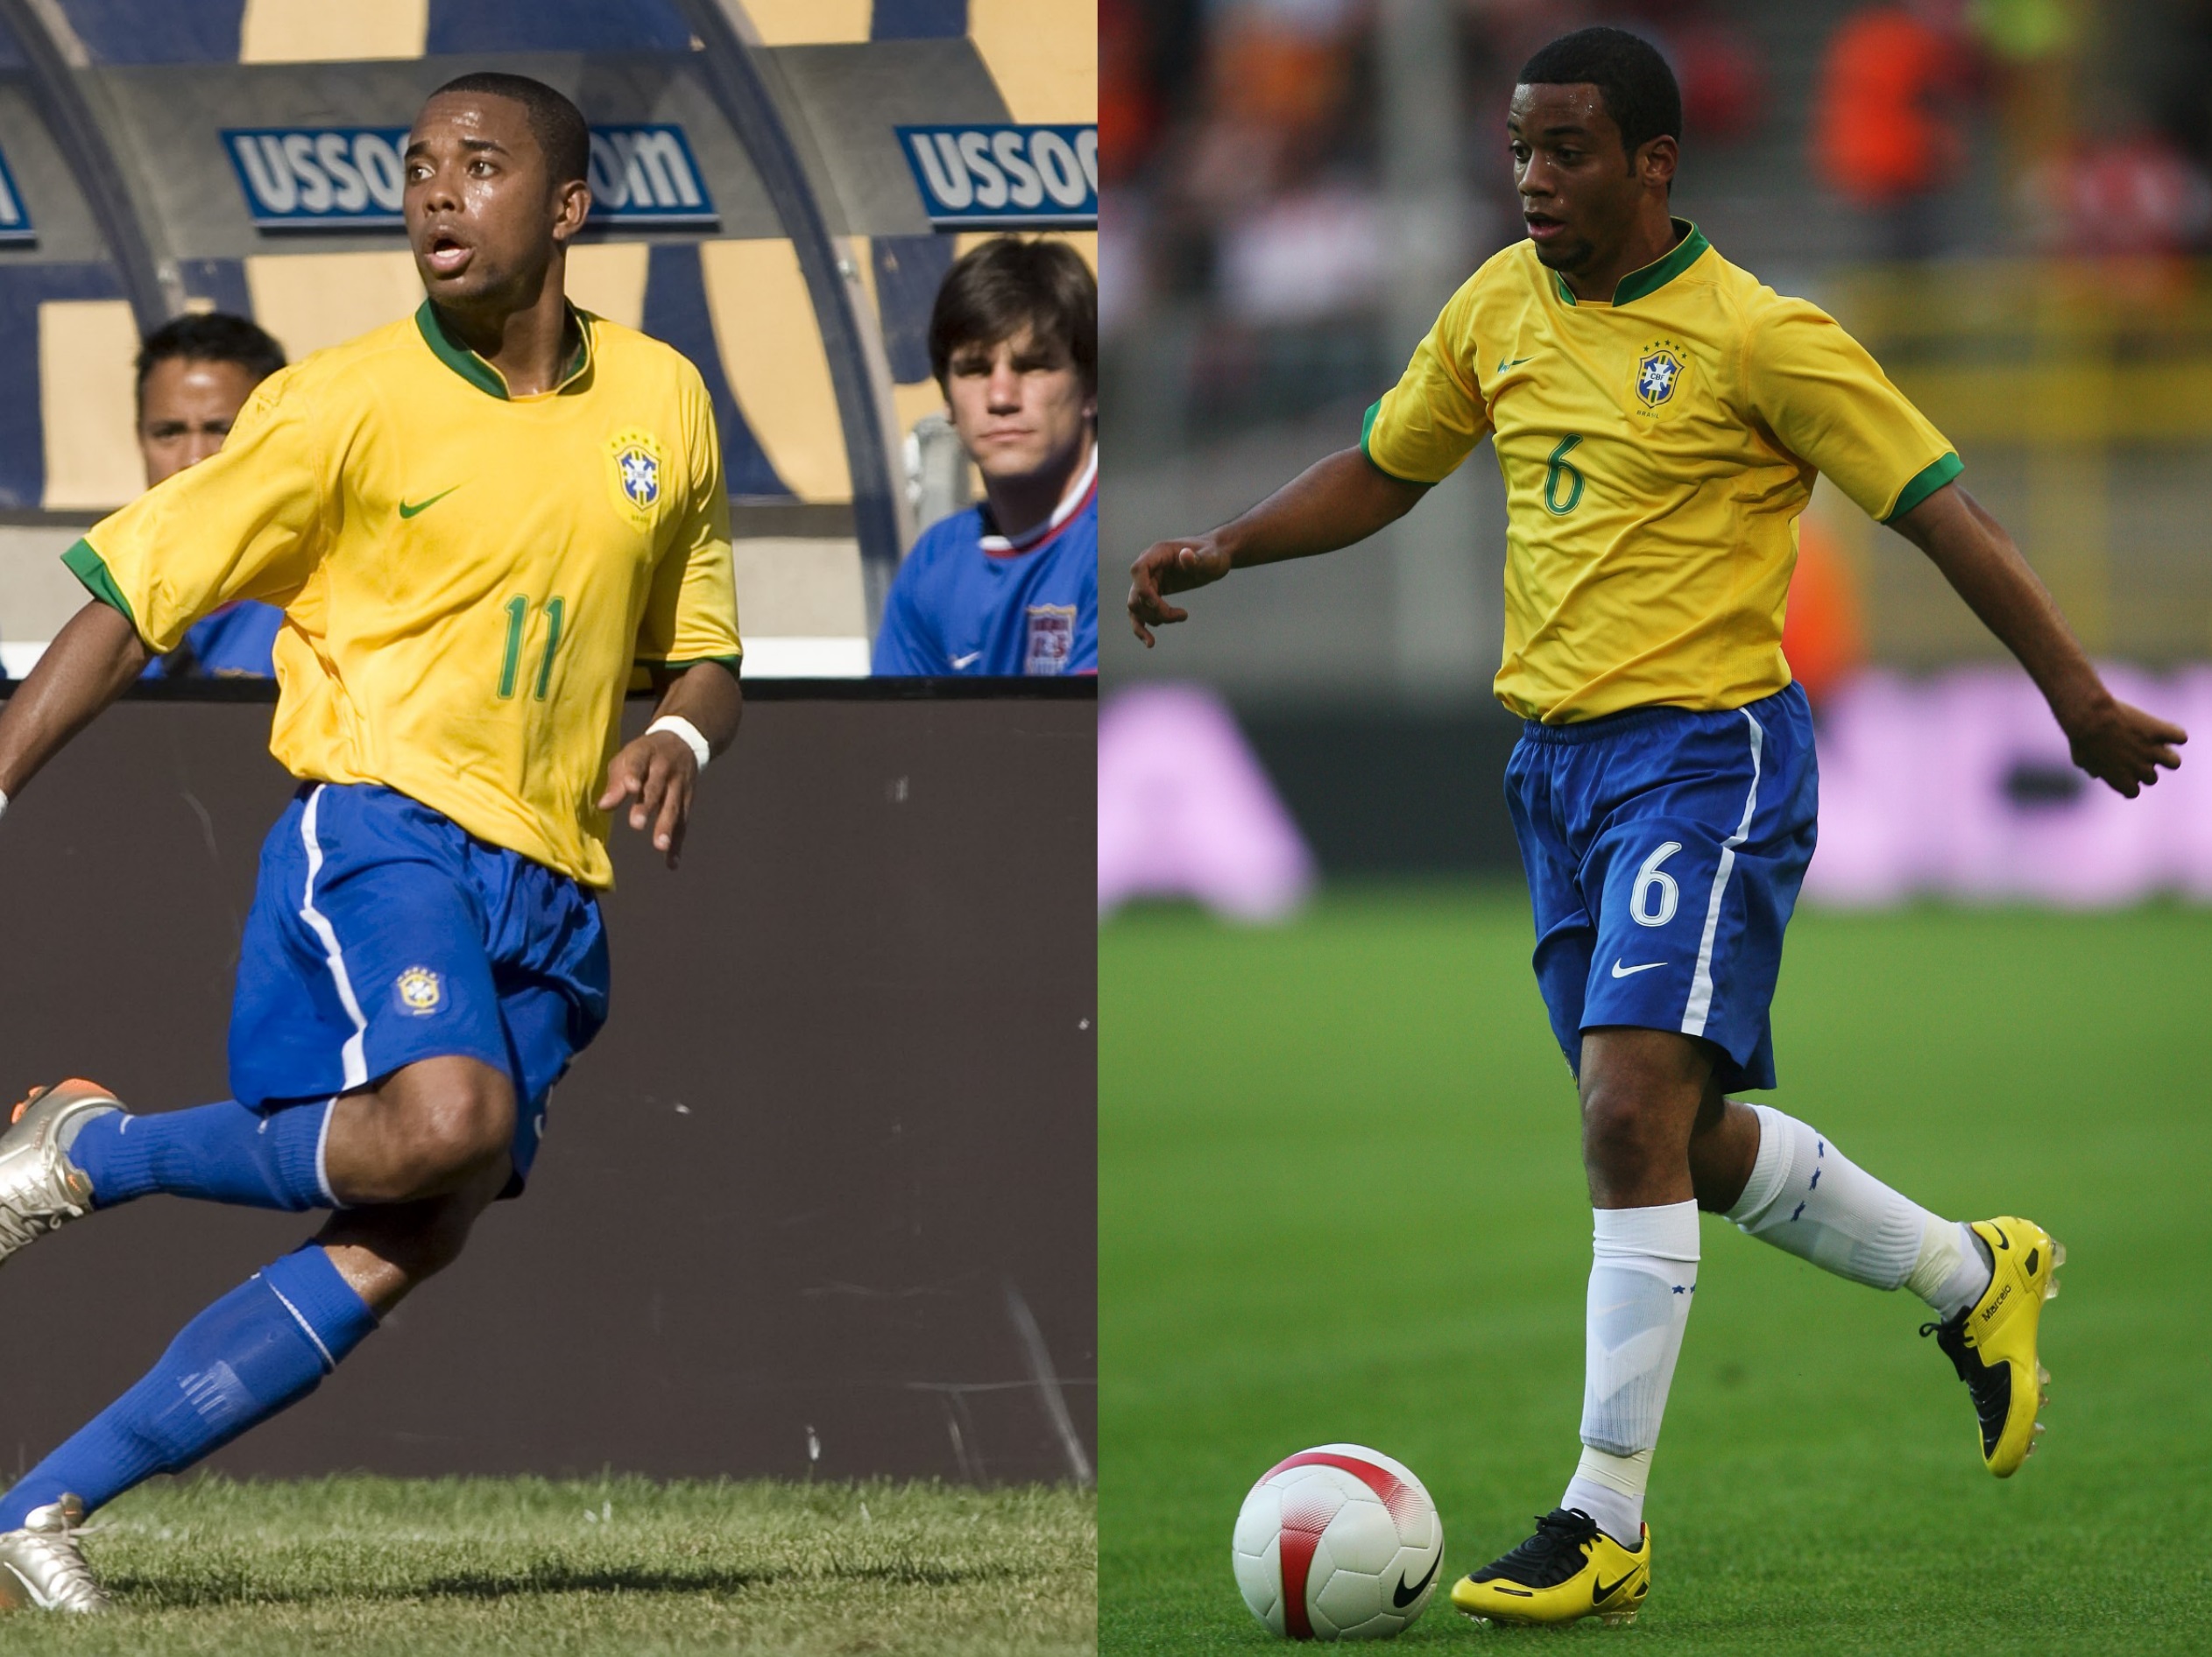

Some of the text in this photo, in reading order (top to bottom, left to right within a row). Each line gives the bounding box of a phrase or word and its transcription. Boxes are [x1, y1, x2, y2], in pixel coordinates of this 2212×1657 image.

[1636, 409, 1659, 420] BRASIL
[1544, 433, 1585, 516] 6
[497, 593, 565, 702] 11
[1630, 841, 1682, 927] 6
[1982, 1284, 2011, 1322] Marcelo
